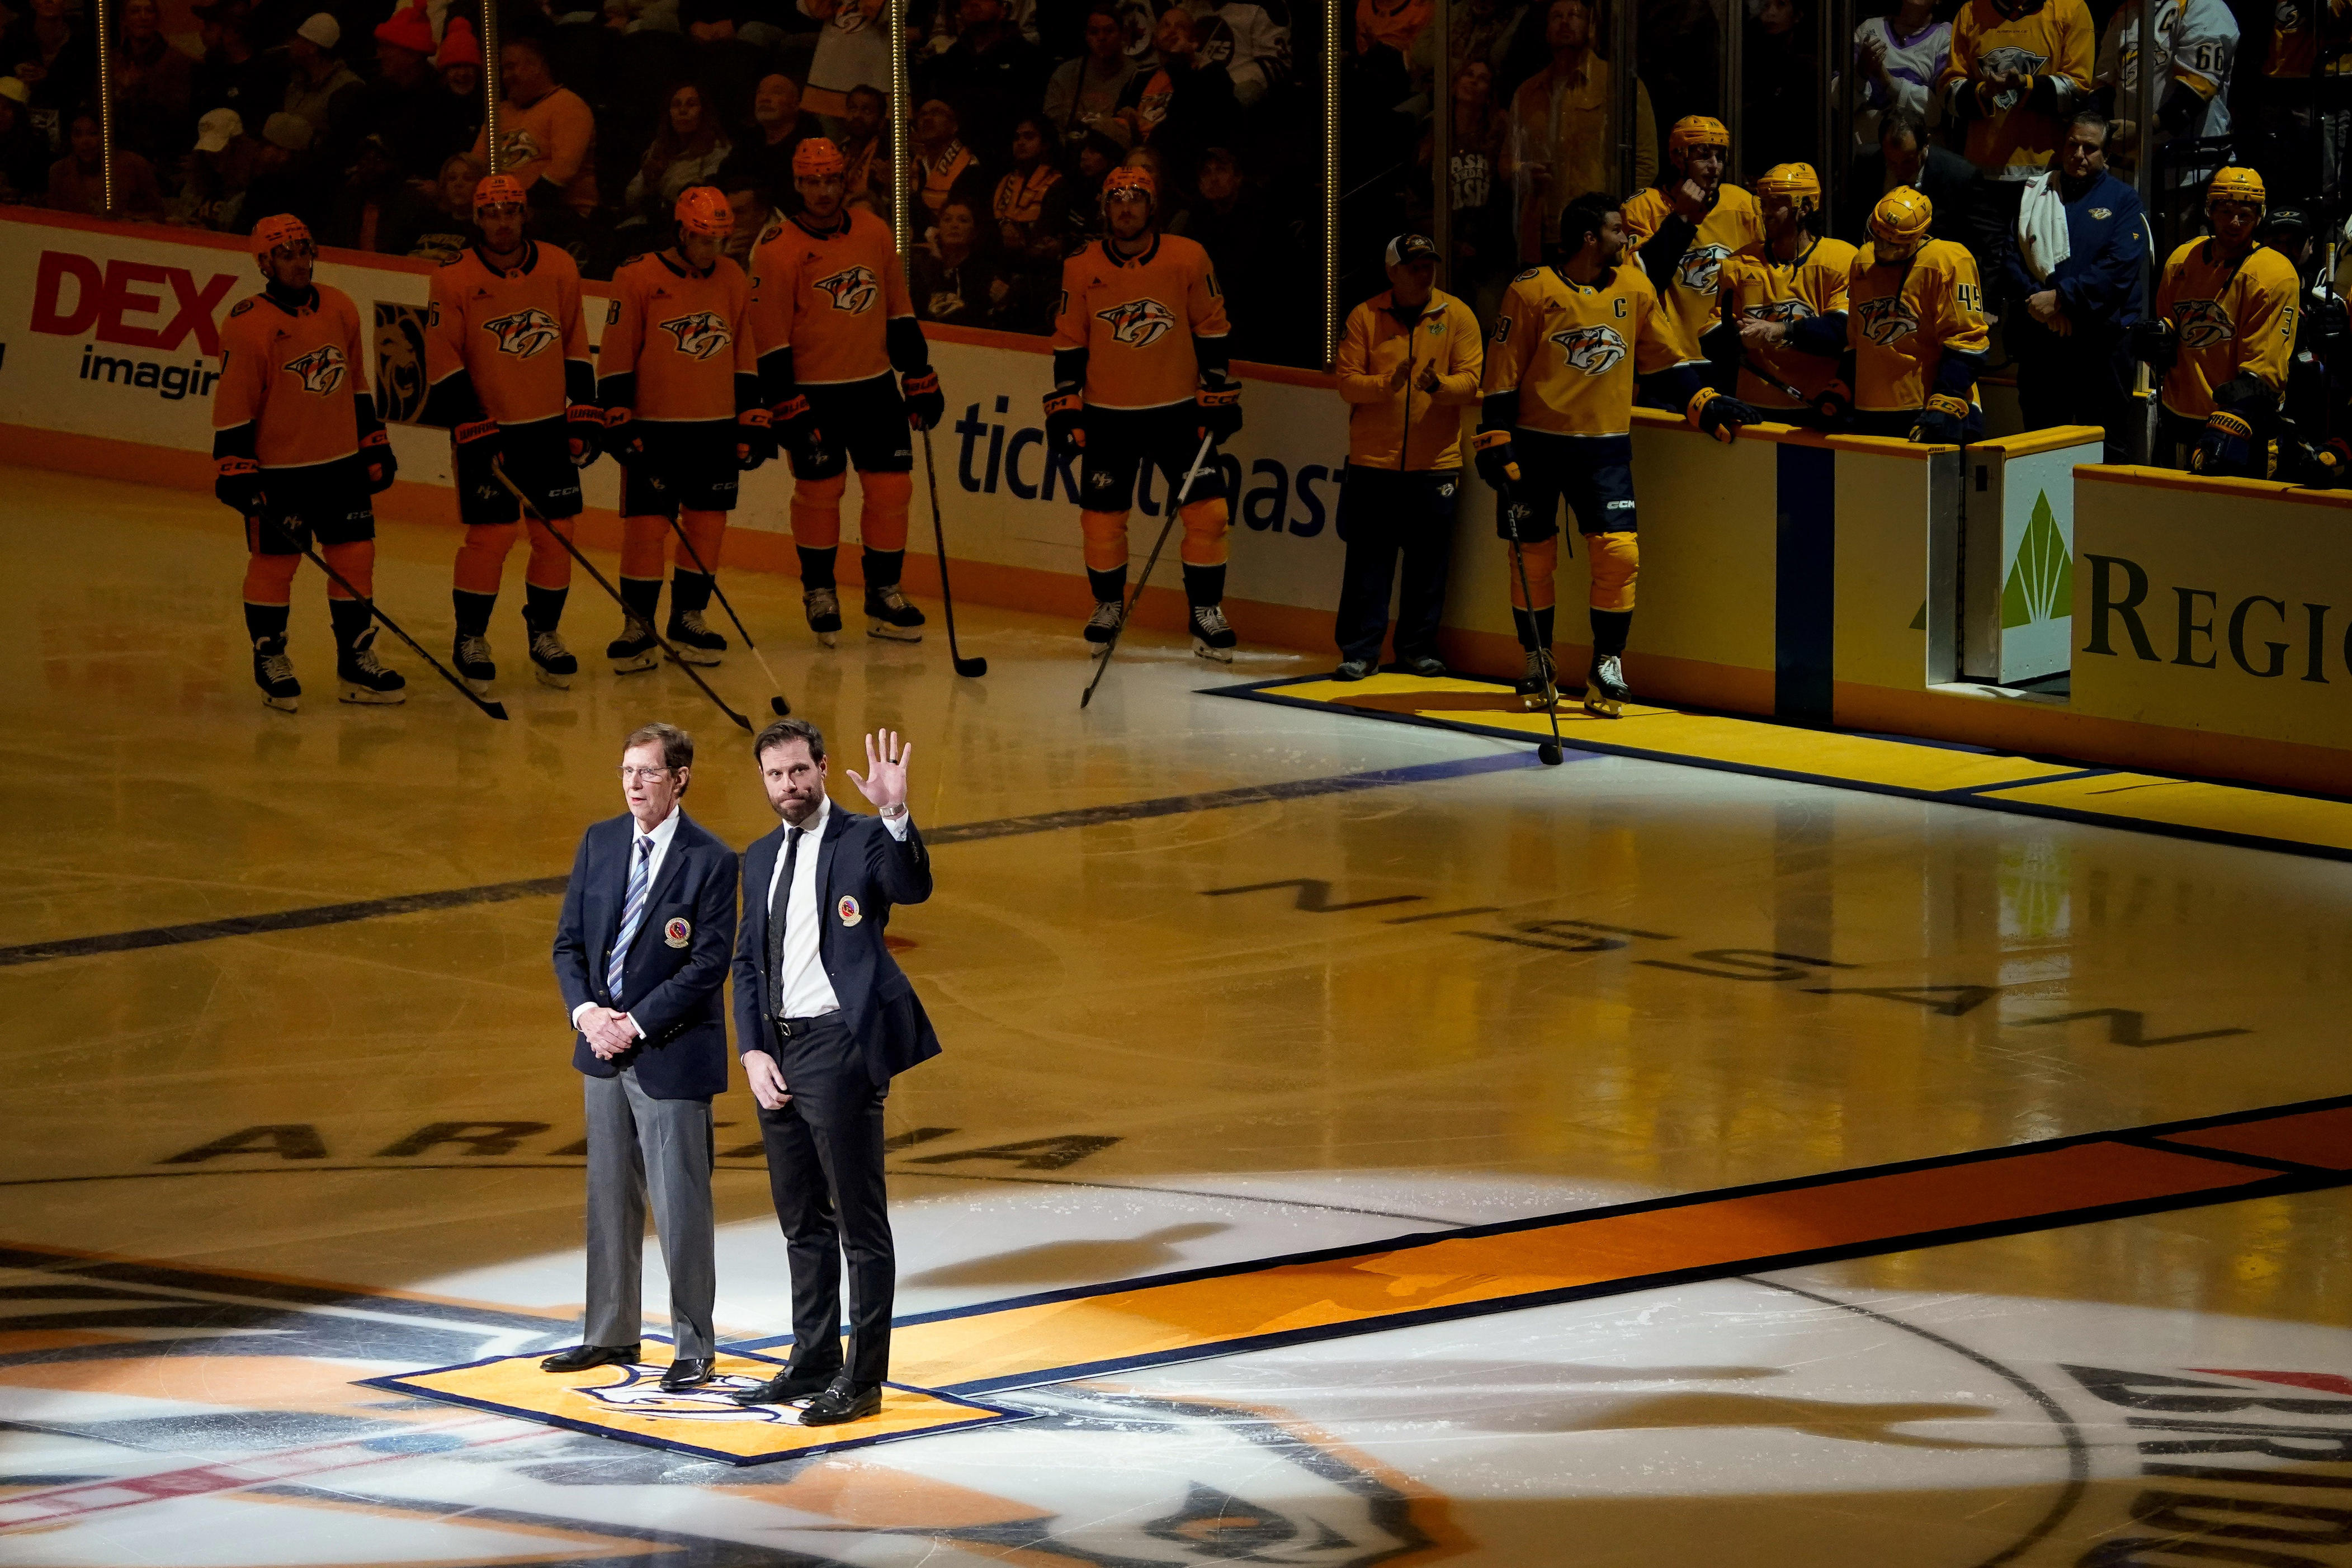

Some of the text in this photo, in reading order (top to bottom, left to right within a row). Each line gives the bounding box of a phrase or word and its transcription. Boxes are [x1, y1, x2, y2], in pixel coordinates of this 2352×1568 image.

[30, 250, 239, 357] DEX
[1613, 297, 1628, 319] C
[1957, 284, 1983, 312] 45
[2280, 306, 2294, 337] 3
[1929, 399, 1966, 418] CCM
[2208, 414, 2250, 437] ARRIO
[1606, 499, 1636, 510] CCM
[2081, 553, 2352, 683] REGI
[159, 1120, 1122, 1172] ARA
